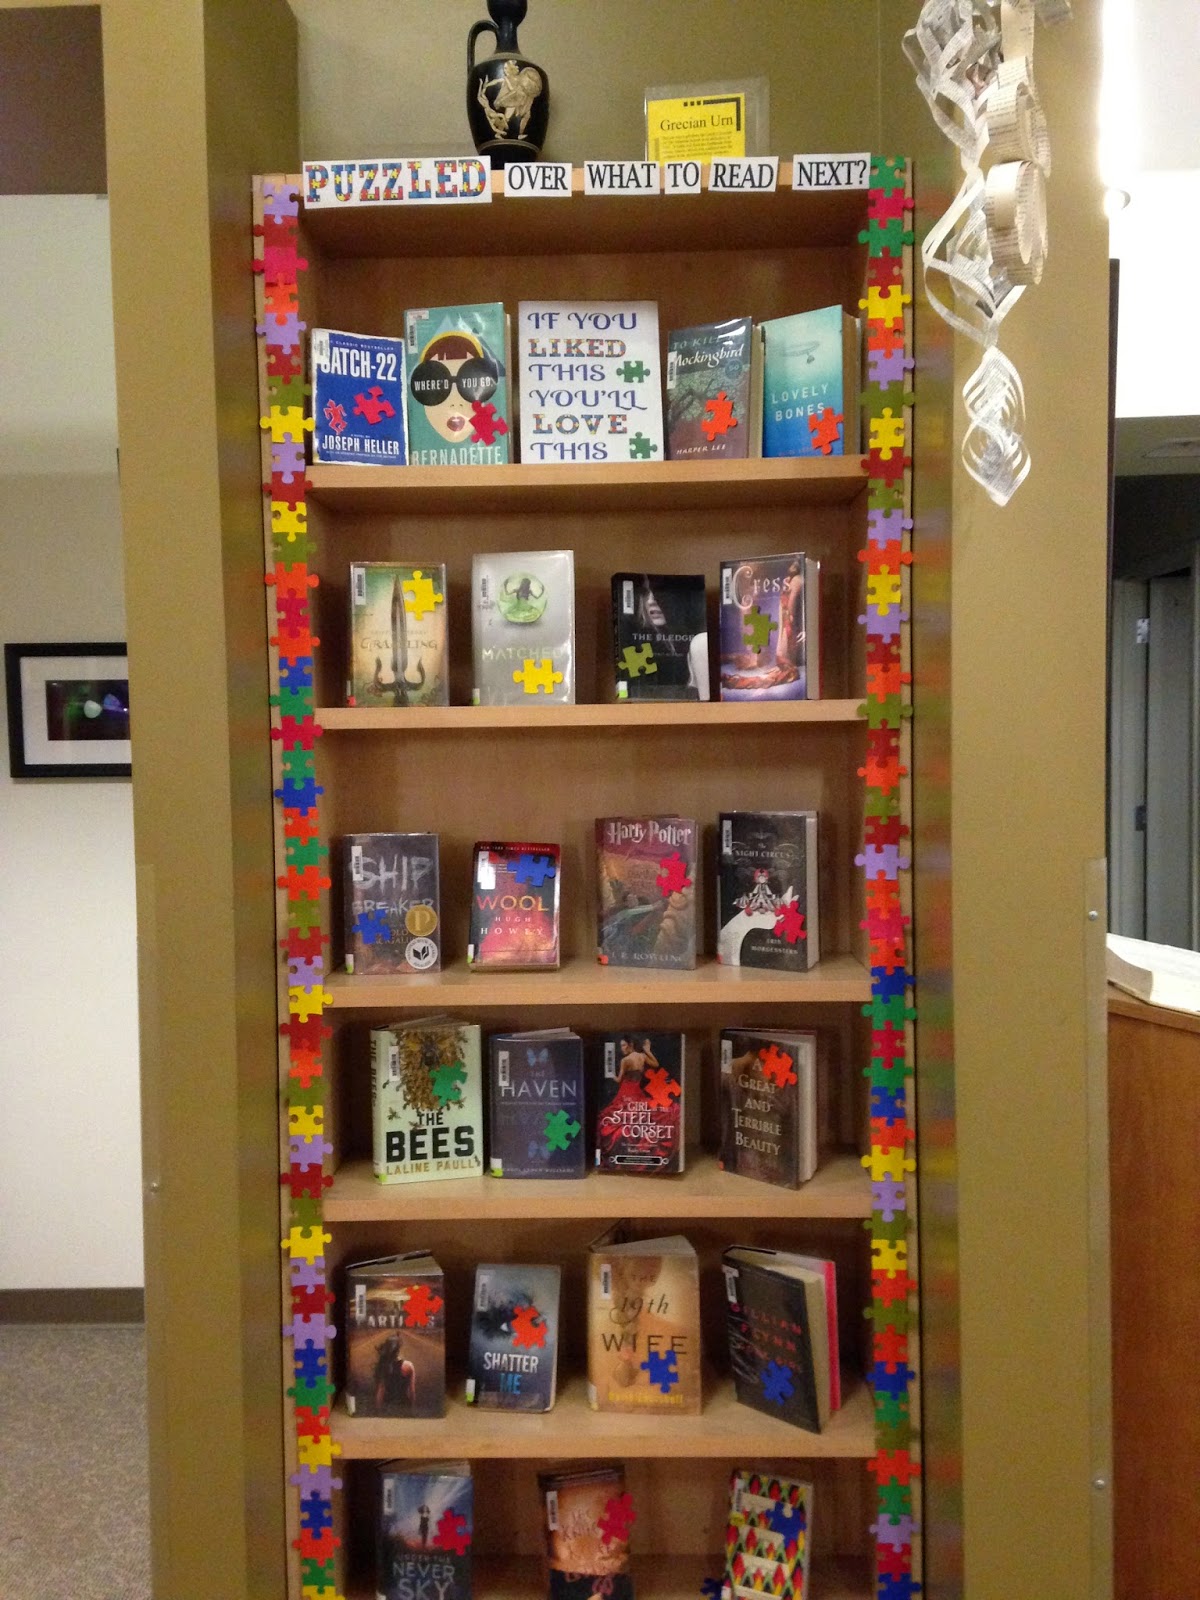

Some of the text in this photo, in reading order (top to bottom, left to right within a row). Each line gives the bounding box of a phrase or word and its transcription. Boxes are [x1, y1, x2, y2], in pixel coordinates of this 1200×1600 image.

[660, 115, 733, 131] Grecian Urn
[305, 159, 867, 202] PUZZLED OVER WHAT TO READ NEXT?
[527, 312, 637, 330] IF YOU
[528, 338, 627, 358] LIKED
[528, 363, 606, 382] THIS
[414, 379, 449, 391] WHERE'D
[462, 377, 477, 388] YOU
[528, 389, 648, 410] YOU'LL
[771, 383, 829, 405] LOVELY
[775, 402, 825, 422] BONES
[532, 413, 628, 435] LOVE
[322, 434, 360, 452] JOSEPH
[364, 438, 400, 455] HELLER
[530, 442, 608, 460] THIS
[676, 446, 708, 455] HARPER
[411, 446, 503, 465] BERNADETTE
[632, 633, 652, 641] THE
[607, 820, 692, 847] Harry Potter
[353, 853, 433, 892] SHIP
[476, 895, 549, 912] WOOL
[481, 927, 544, 935] HOWEY
[501, 1080, 577, 1098] HAVEN
[602, 1104, 656, 1126] STEEL
[627, 1101, 651, 1111] GIRL
[744, 1098, 773, 1113] AND
[417, 1112, 444, 1125] THE
[621, 1125, 674, 1143] CORSET
[386, 1125, 475, 1163] BEES
[386, 1159, 472, 1176] LALINE PAULL
[601, 1333, 687, 1355] WIFE
[483, 1352, 539, 1373] SHATTER
[500, 1373, 522, 1395] ME
[392, 1561, 455, 1583] NEVER
[398, 1577, 451, 1600] SKY
